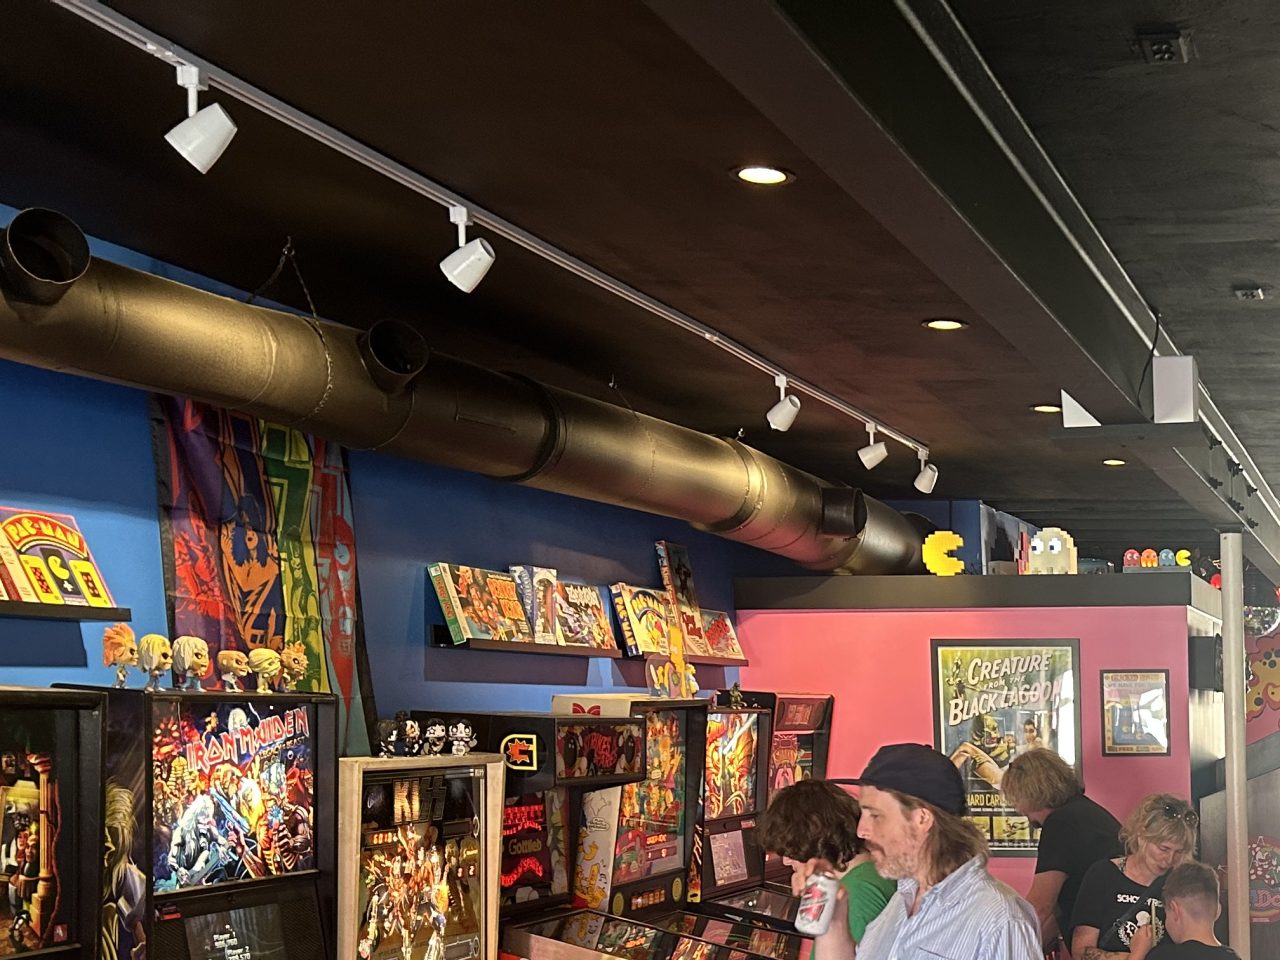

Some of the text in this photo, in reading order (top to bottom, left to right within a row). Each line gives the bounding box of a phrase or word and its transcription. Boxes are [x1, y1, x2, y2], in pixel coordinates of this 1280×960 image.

[4, 517, 80, 549] PAC-MAN
[614, 596, 637, 647] PAC-MAN
[968, 654, 1053, 685] CREATURE
[984, 675, 1025, 690] FROM THE
[949, 677, 1063, 726] BLACK LAGOON
[186, 705, 310, 775] IRON MAIDEN
[393, 776, 447, 825] KISS
[508, 838, 542, 855] Gottlieb
